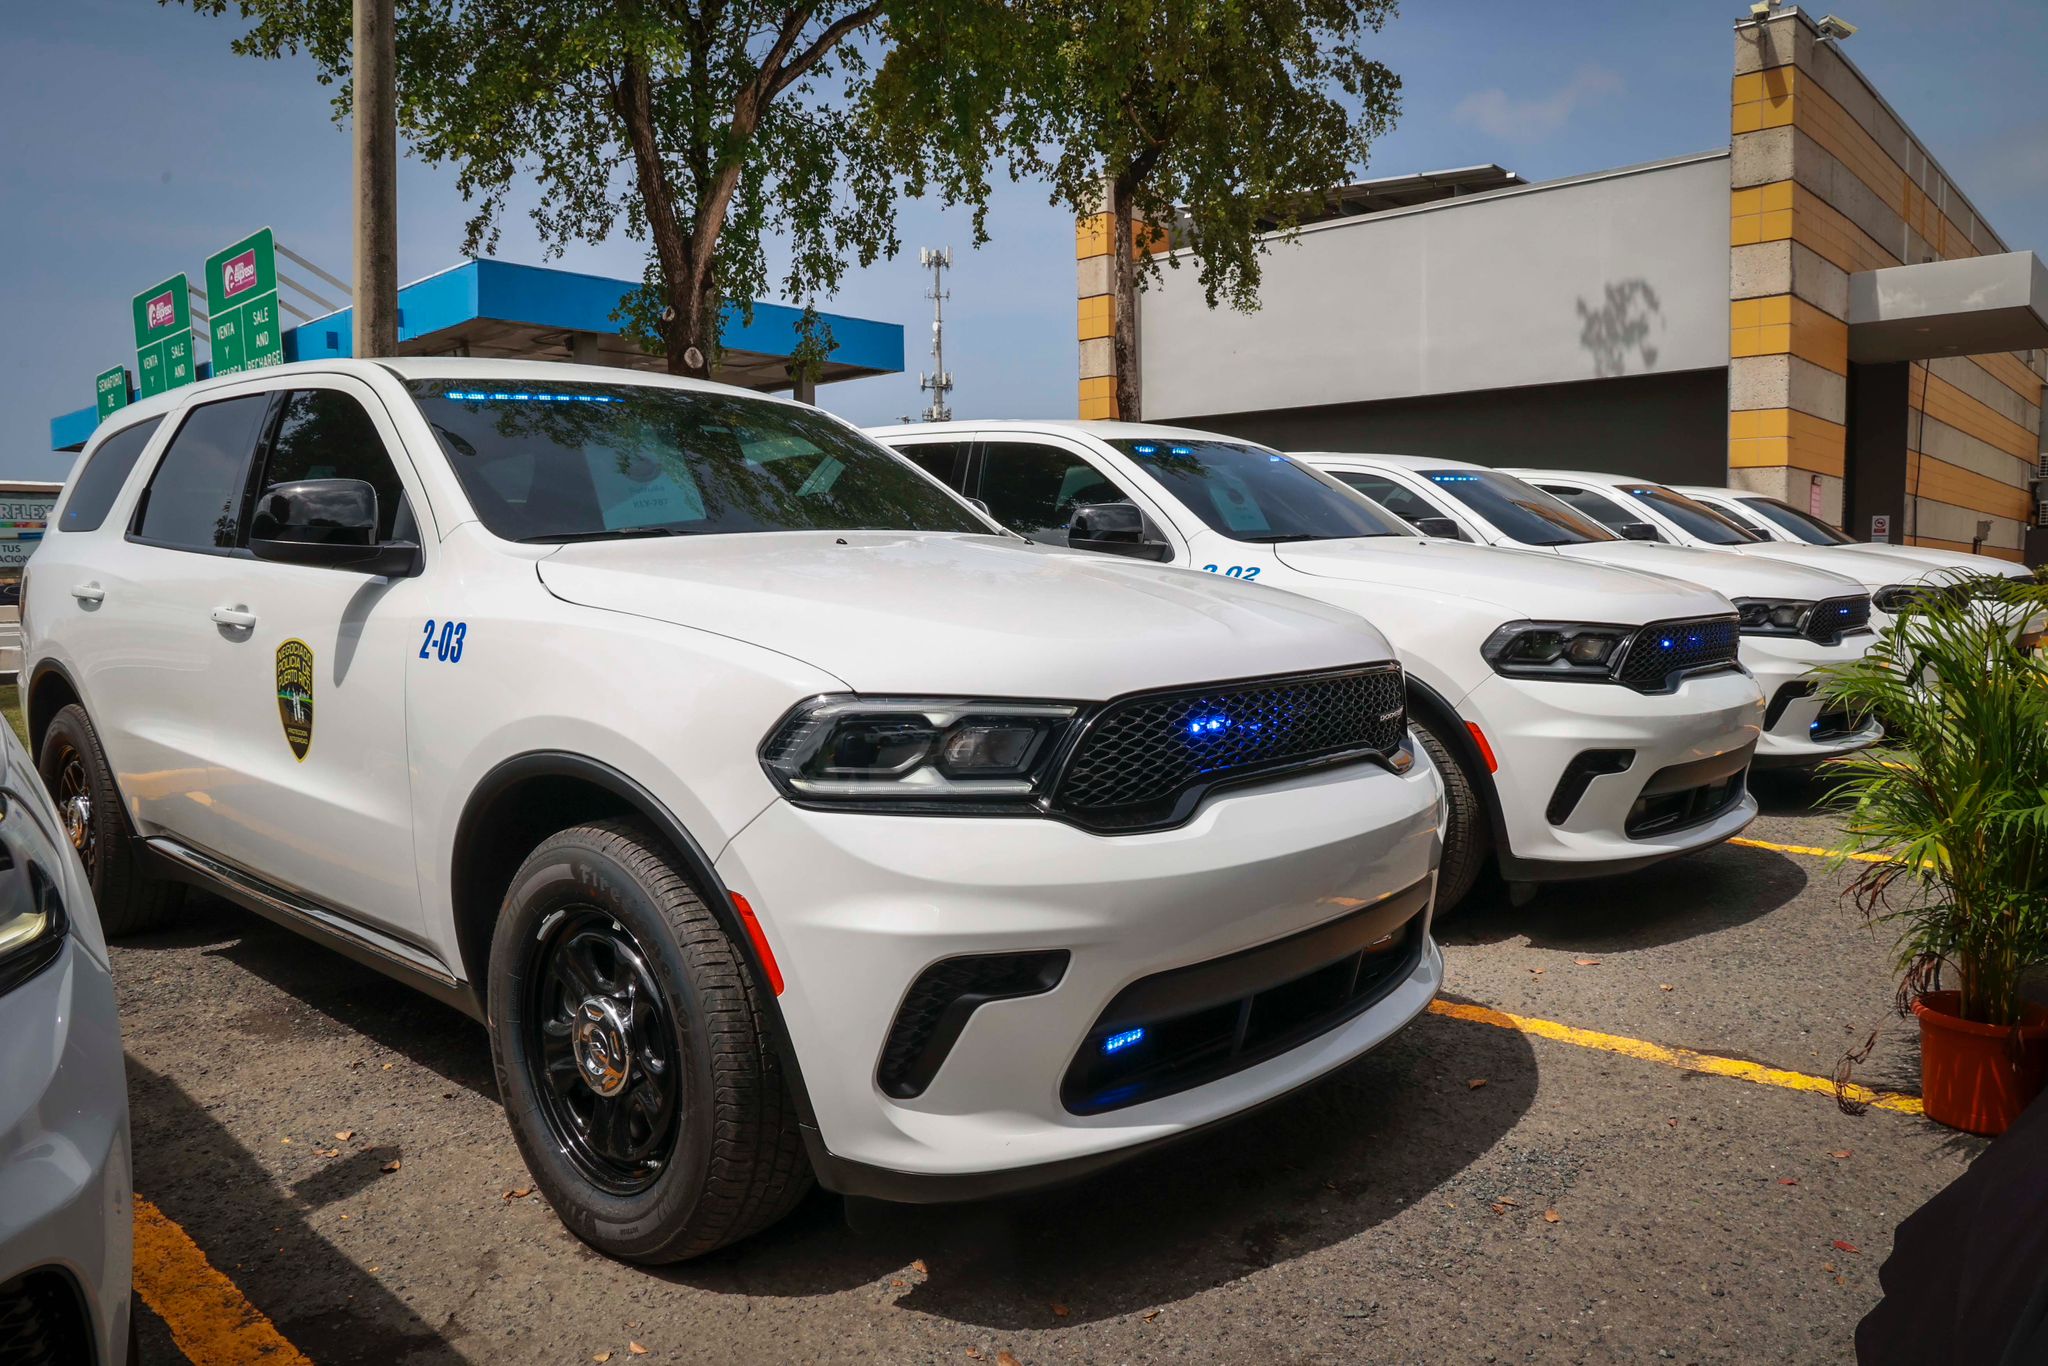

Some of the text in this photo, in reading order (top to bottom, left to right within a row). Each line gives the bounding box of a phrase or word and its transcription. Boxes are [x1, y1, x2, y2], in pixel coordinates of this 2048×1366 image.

[253, 307, 269, 326] SALE
[217, 322, 235, 341] VENTA
[256, 331, 269, 348] AND
[172, 343, 185, 359] SALE
[224, 345, 230, 360] Y
[144, 355, 158, 370] VENTA
[248, 351, 281, 370] RECHARGE
[175, 364, 186, 379] AND
[150, 375, 155, 388] Y
[2, 544, 21, 553] TUS
[418, 618, 467, 664] 2-03
[277, 643, 312, 666] NEGOCIADO
[301, 660, 312, 681] DE
[278, 669, 298, 691] PUERTO
